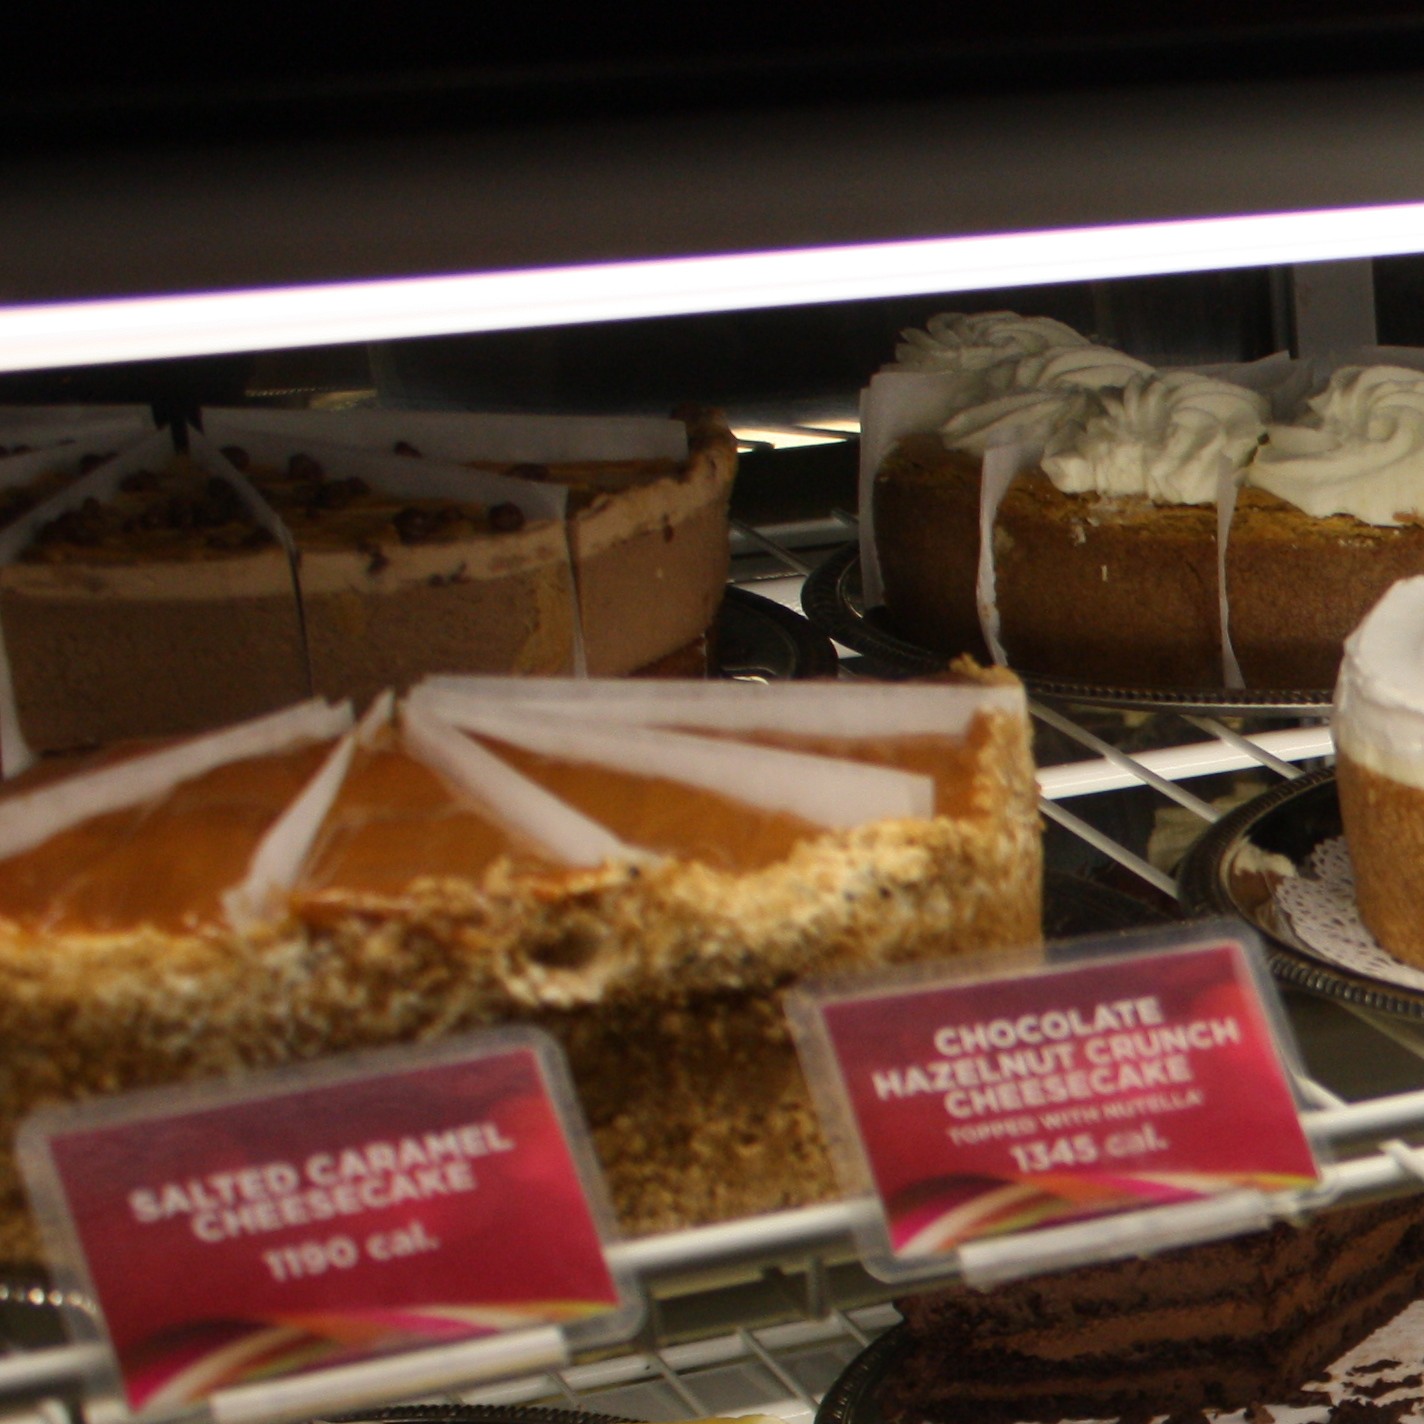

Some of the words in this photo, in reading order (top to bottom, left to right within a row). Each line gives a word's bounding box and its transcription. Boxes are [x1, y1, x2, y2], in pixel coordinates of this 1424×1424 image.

[934, 997, 1164, 1056] CHOCOLATE
[872, 1047, 1074, 1099] HAZELNUT
[1087, 1018, 1239, 1065] CRUNCH
[944, 1055, 1191, 1118] CHEESECAKE
[948, 1116, 1037, 1146] TOPPED
[1010, 1134, 1096, 1173] 1345
[1106, 1124, 1168, 1156] cal.
[129, 1163, 298, 1222] SALTED
[307, 1122, 515, 1184] CARAMEL
[193, 1162, 477, 1243] CHEESECAKE
[264, 1234, 357, 1282] 1190
[366, 1220, 439, 1260] cal.
